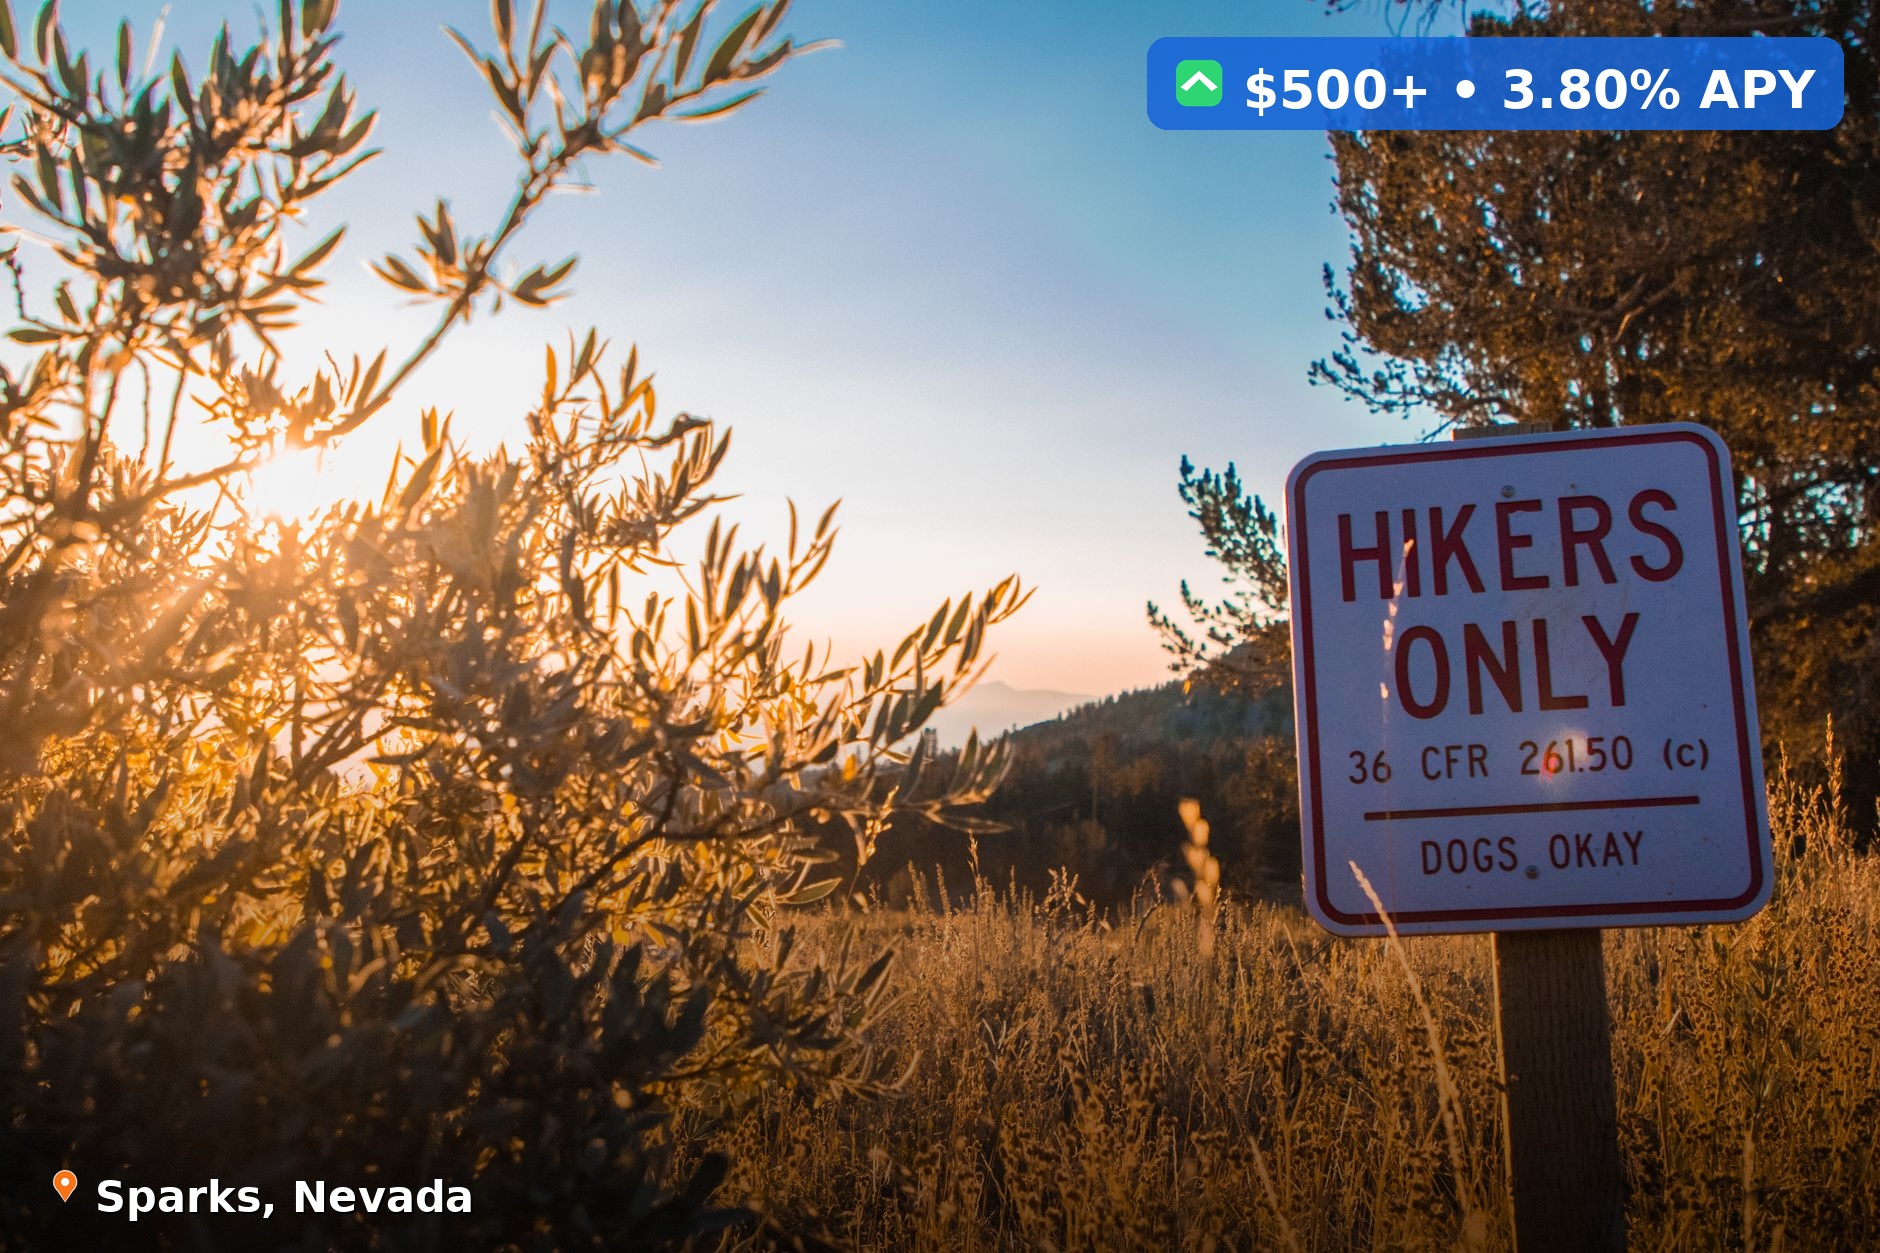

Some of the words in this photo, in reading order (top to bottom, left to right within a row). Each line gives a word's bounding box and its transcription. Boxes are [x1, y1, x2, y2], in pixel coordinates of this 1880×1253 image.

[1338, 489, 1684, 602] HIKERS
[1395, 612, 1640, 719] ONLY
[1349, 750, 1392, 784] 36
[1421, 744, 1489, 782] CFR
[1519, 735, 1633, 775] 261.50
[1663, 738, 1710, 771] (c)
[1421, 836, 1518, 875] DOGS
[1549, 831, 1644, 870] OKAY
